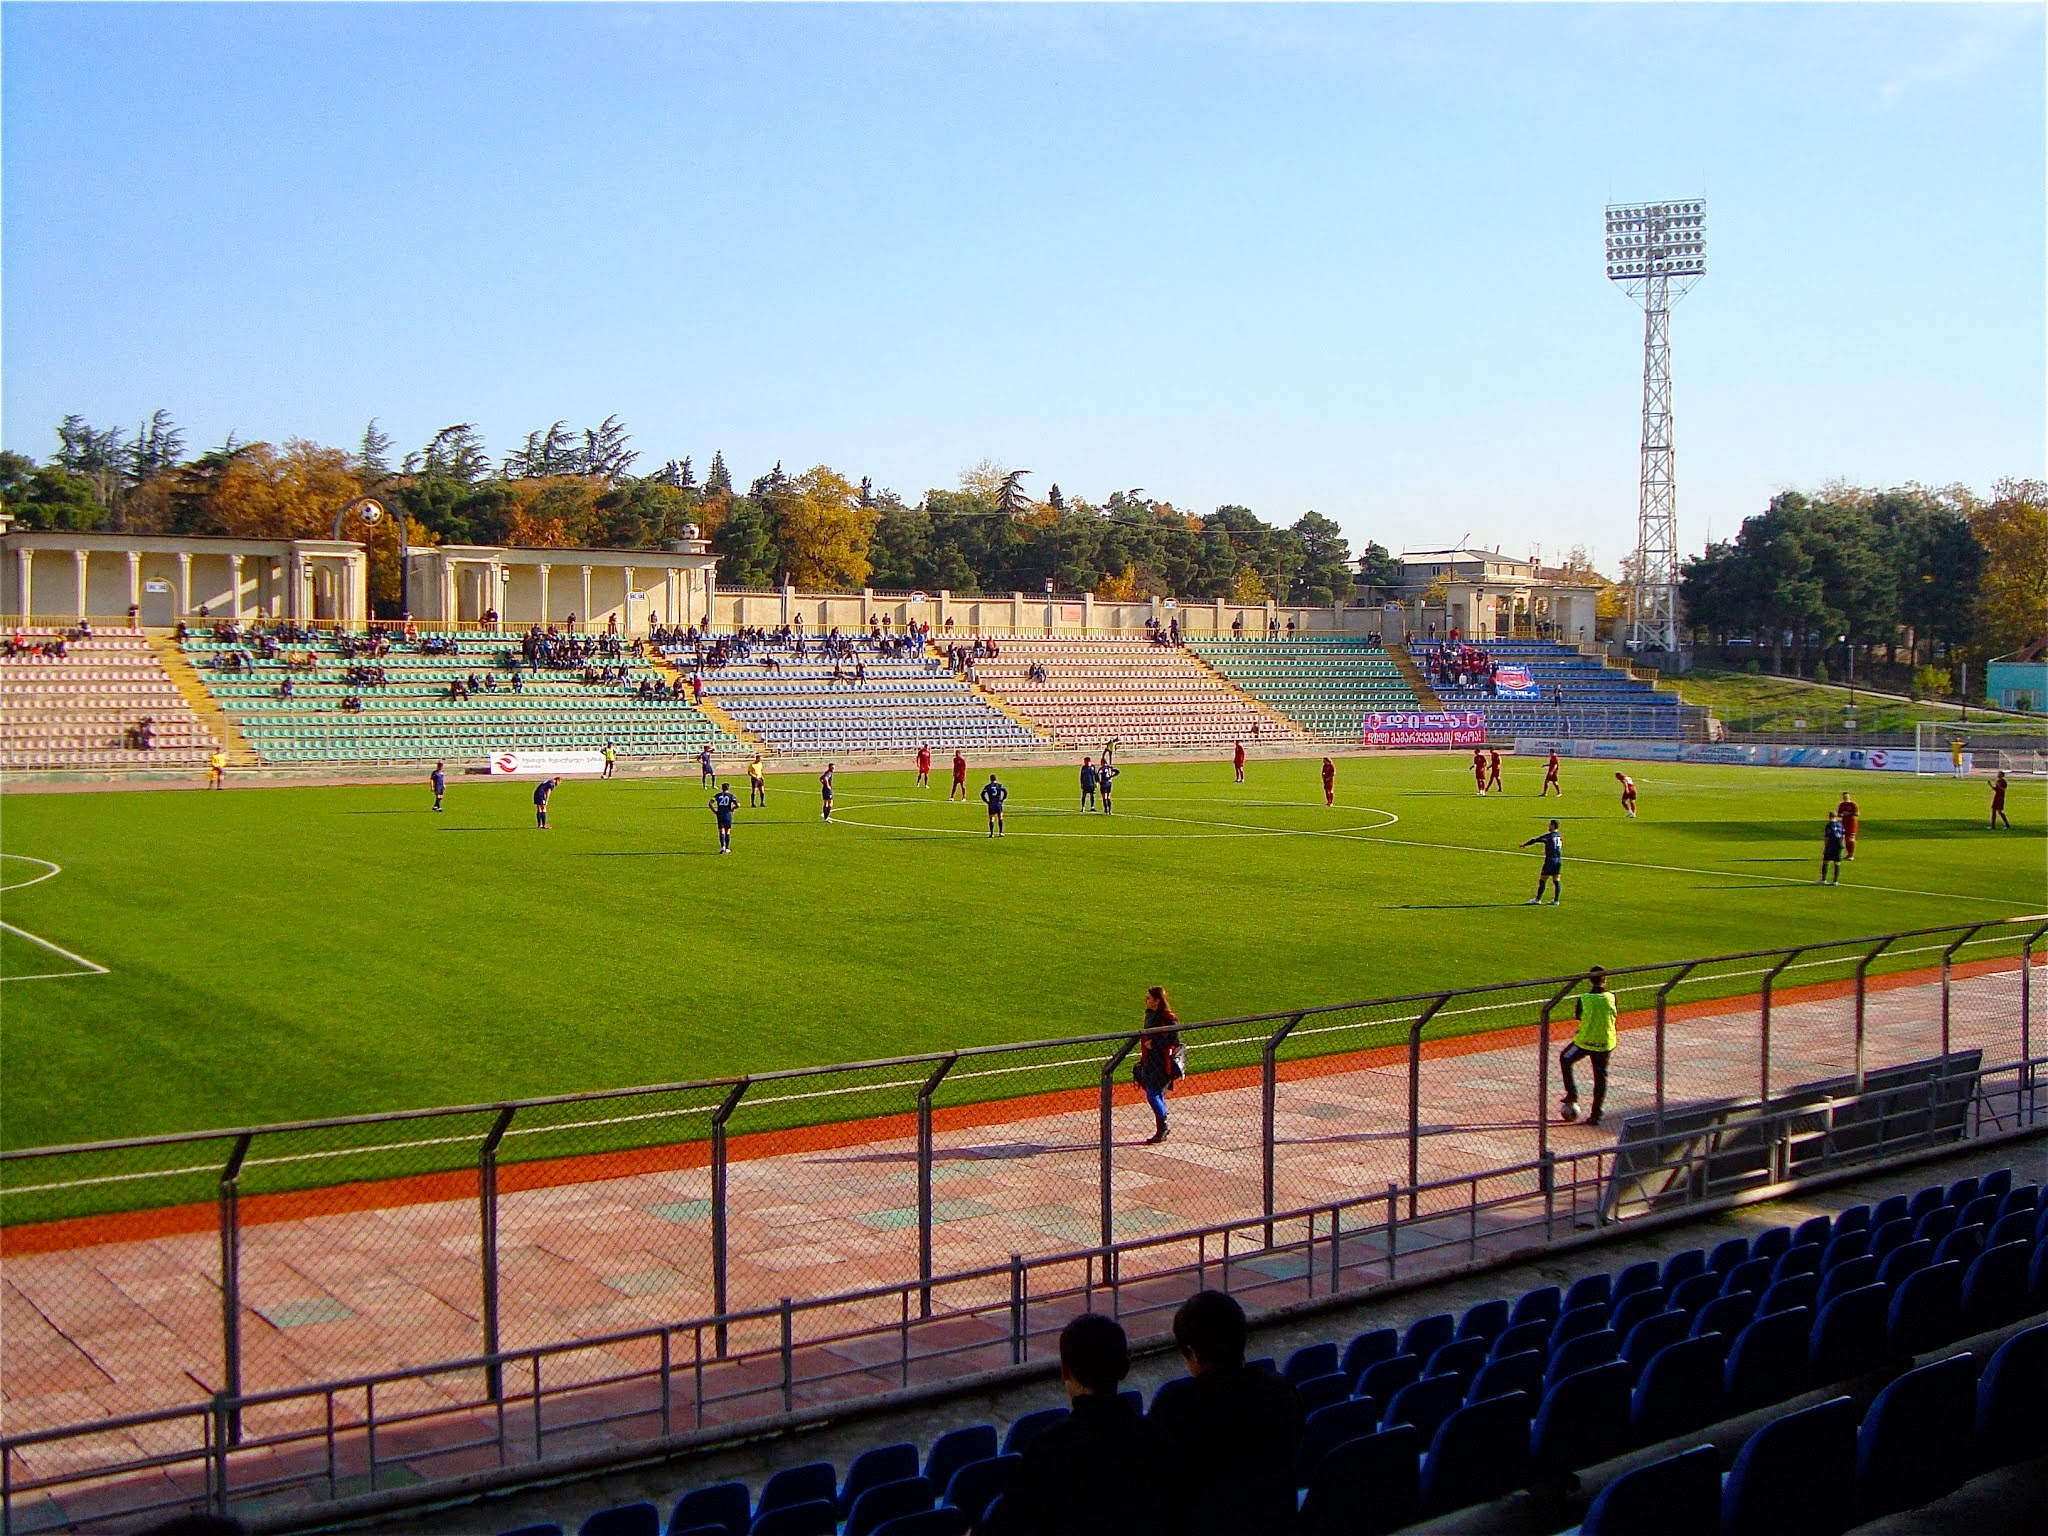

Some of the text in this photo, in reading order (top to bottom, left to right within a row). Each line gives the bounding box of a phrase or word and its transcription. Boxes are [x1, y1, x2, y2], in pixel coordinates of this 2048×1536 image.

[1386, 714, 1461, 729] დილა
[991, 786, 998, 796] 3
[719, 795, 729, 806] 20
